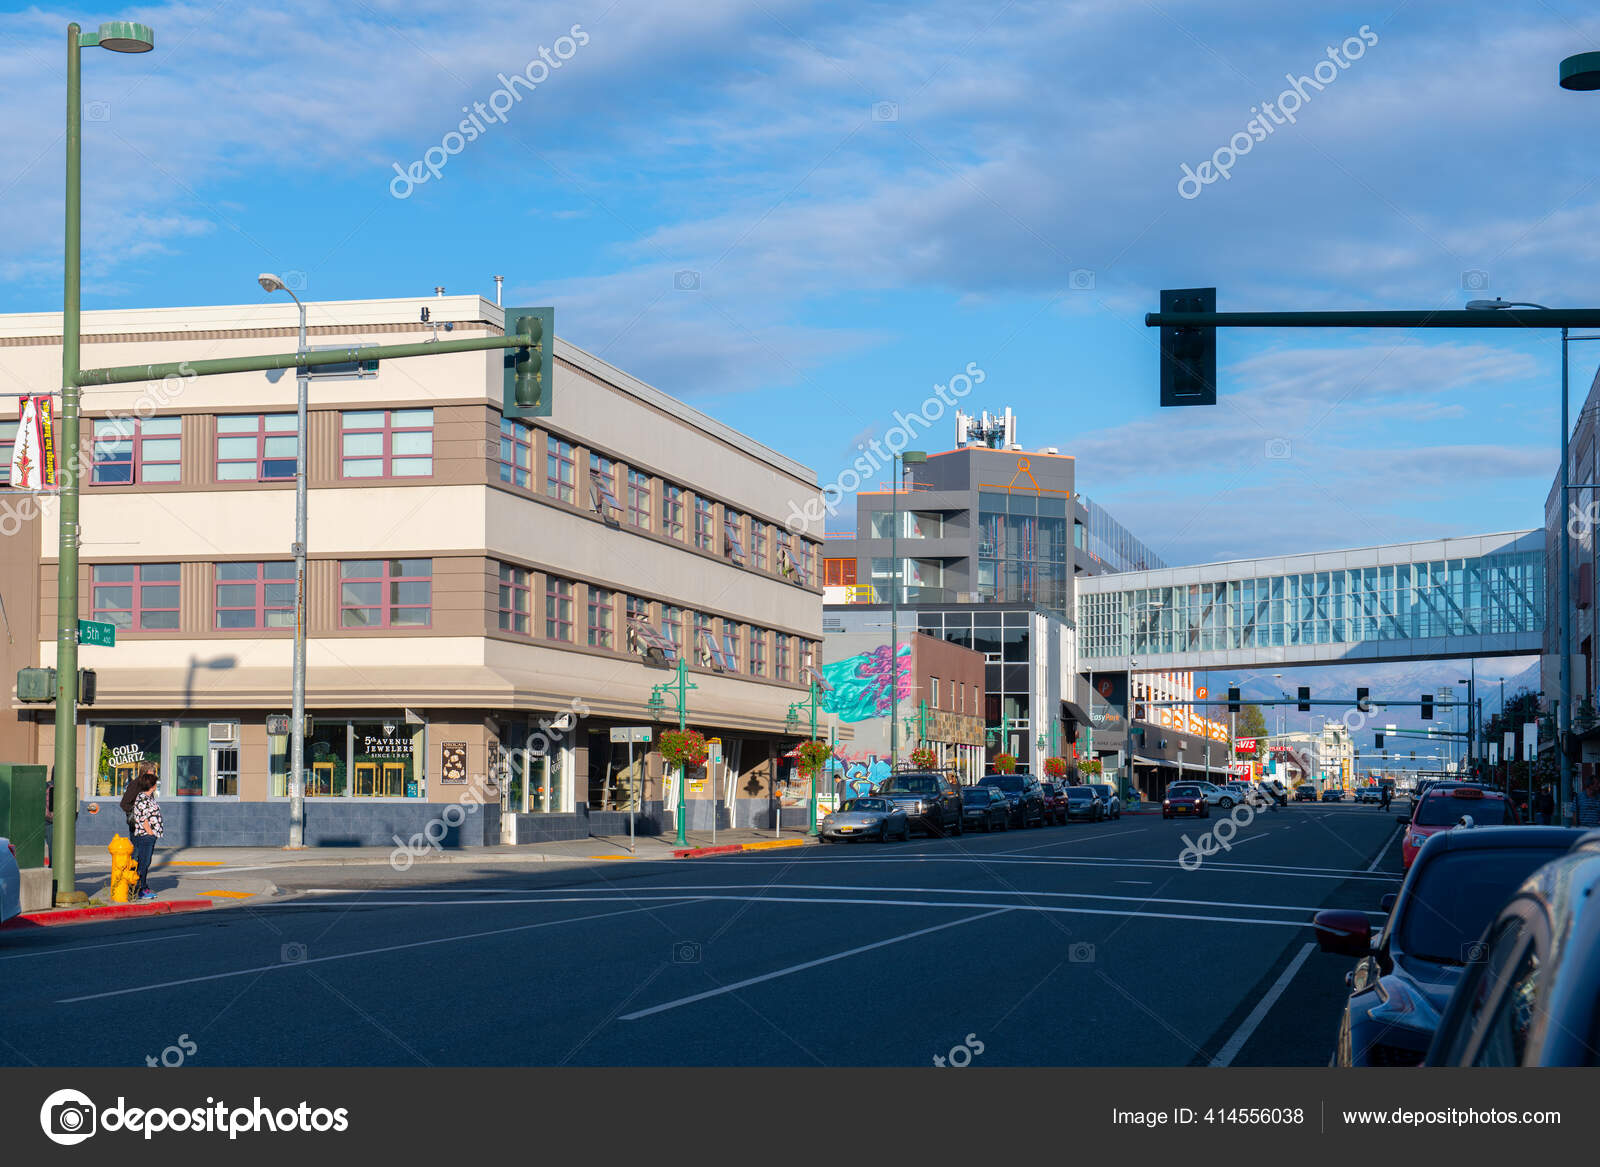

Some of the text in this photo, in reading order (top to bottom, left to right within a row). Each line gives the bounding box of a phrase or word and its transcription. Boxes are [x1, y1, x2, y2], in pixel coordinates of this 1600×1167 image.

[45, 451, 55, 484] Anchorage
[87, 626, 100, 640] 5th
[112, 743, 139, 757] GOLD
[365, 745, 415, 754] JEWELERS
[108, 751, 145, 768] QUARTZ
